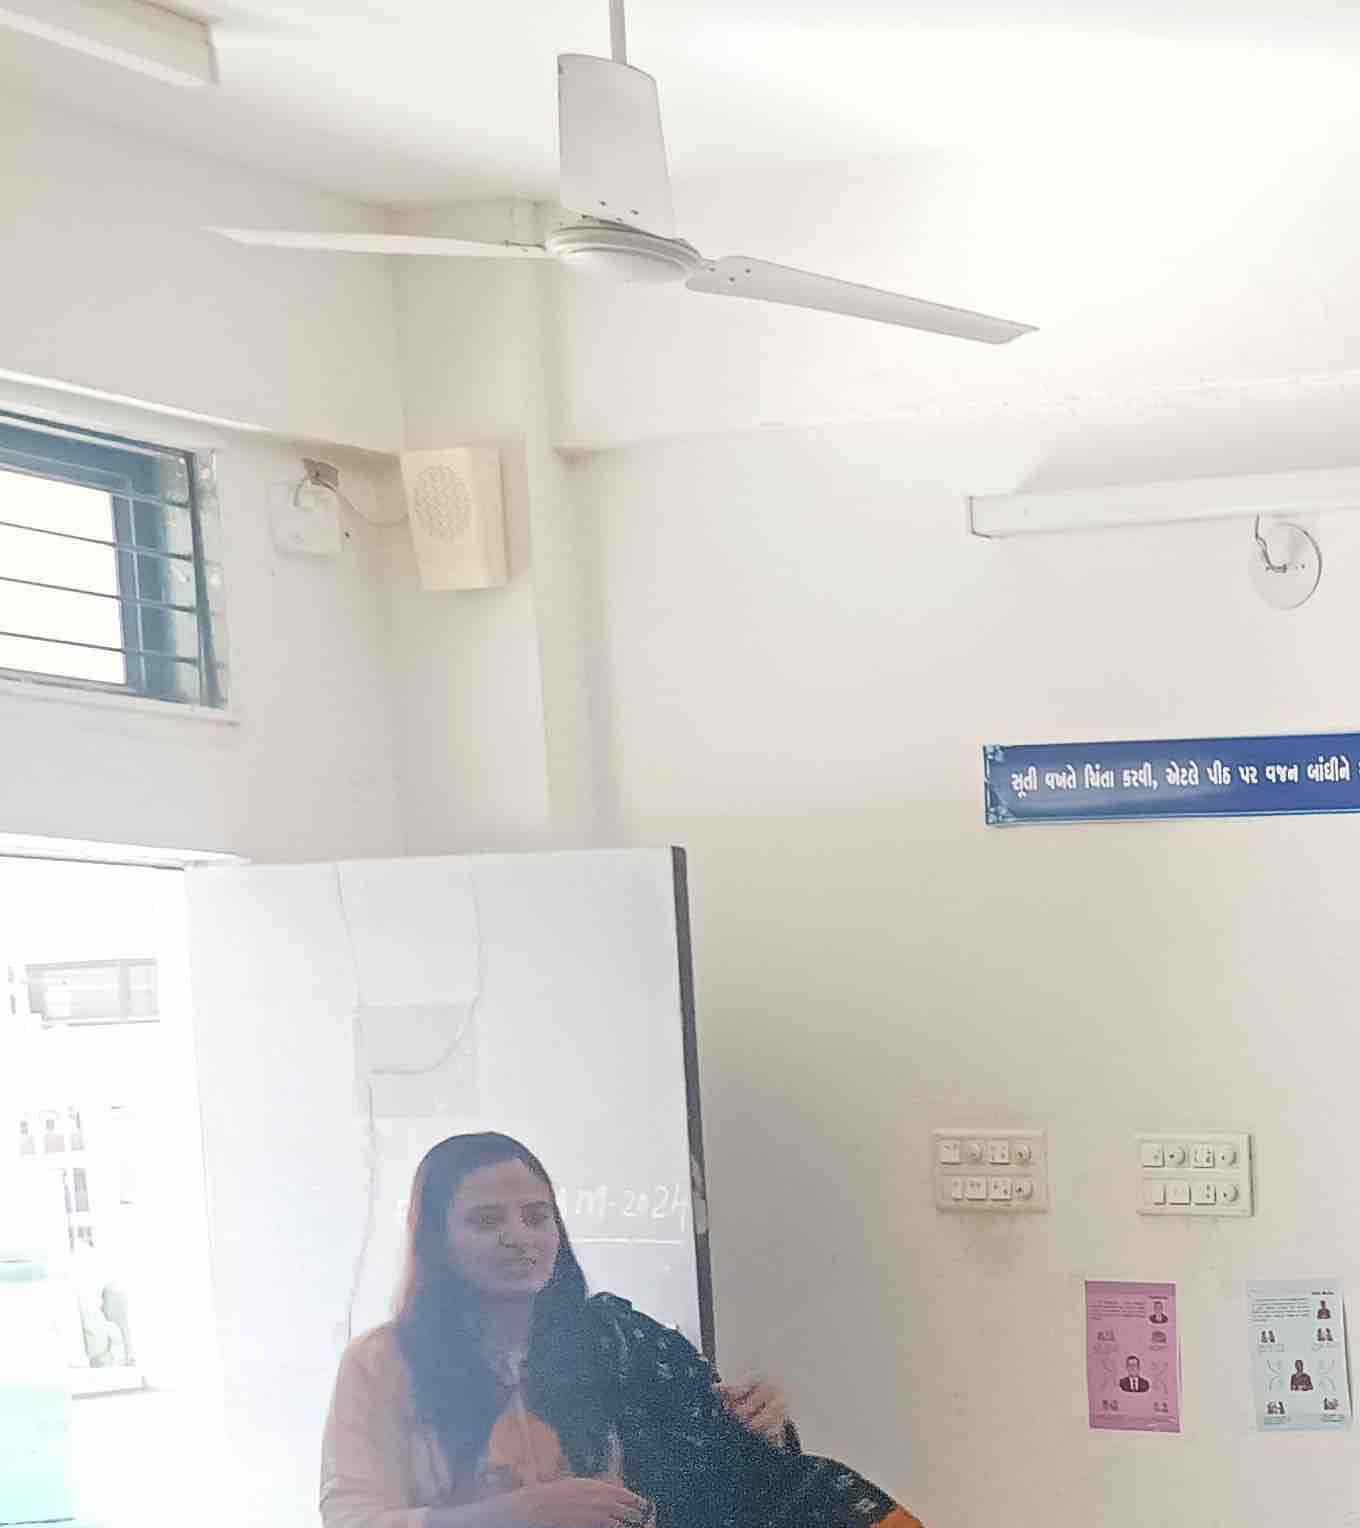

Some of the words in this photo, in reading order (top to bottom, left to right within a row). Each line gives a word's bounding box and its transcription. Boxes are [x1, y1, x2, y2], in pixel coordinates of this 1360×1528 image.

[1164, 760, 1200, 787] એટલે
[1238, 766, 1258, 784] પર
[1265, 763, 1299, 783] વજન
